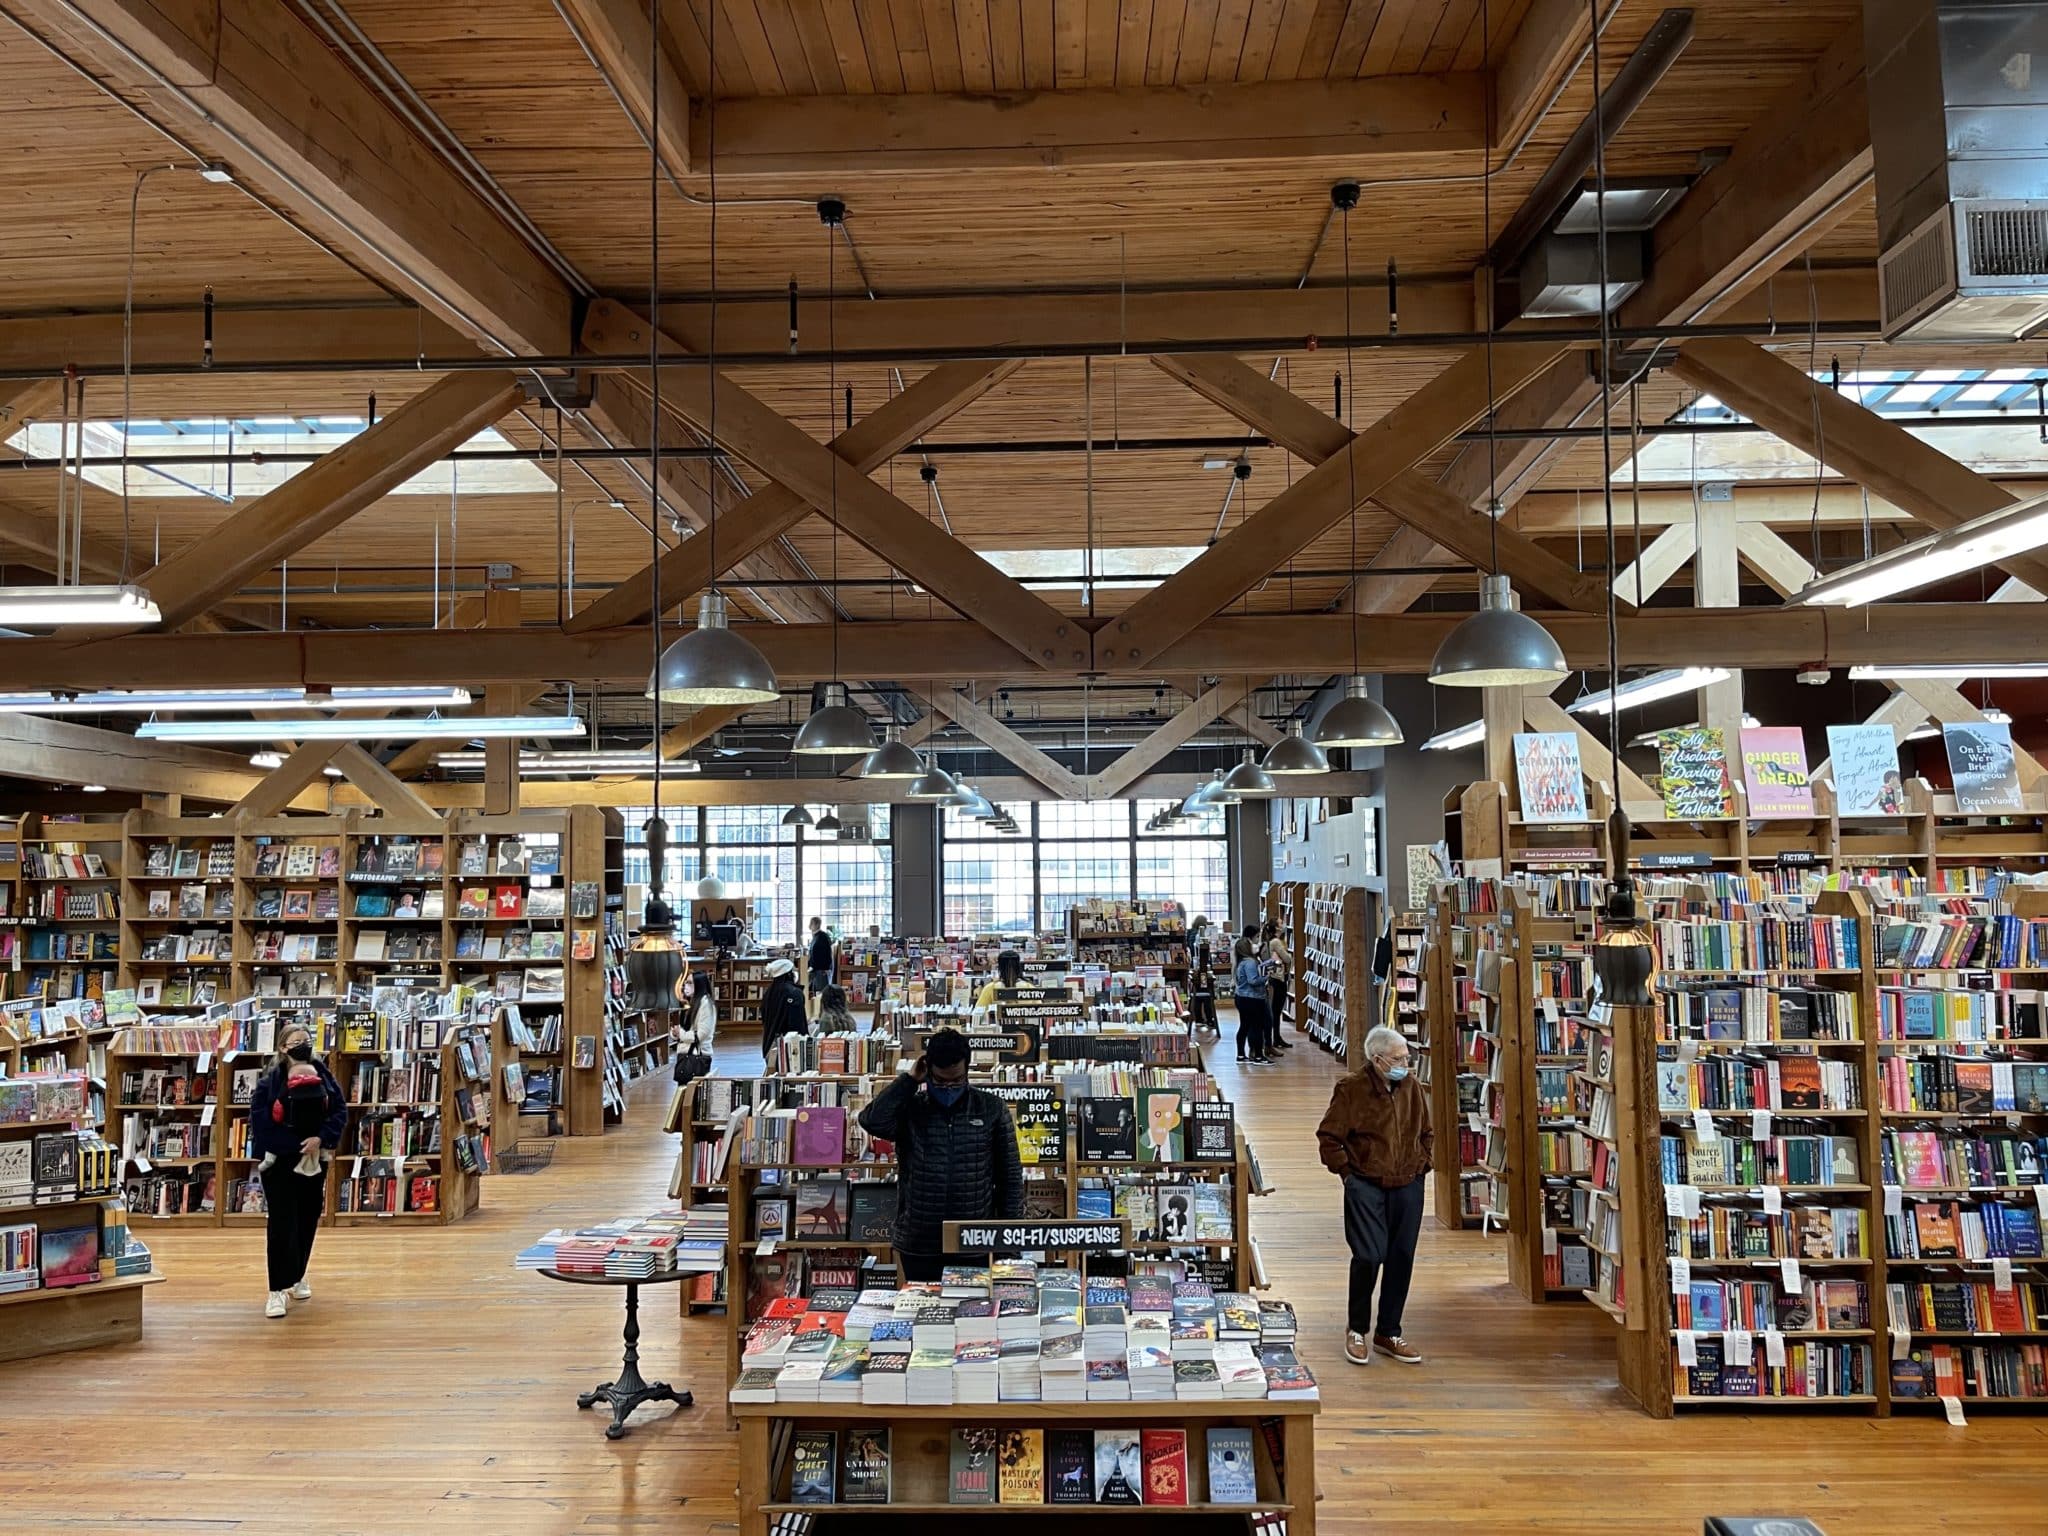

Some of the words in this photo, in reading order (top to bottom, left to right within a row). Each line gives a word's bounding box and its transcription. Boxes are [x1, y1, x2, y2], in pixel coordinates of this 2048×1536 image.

[1680, 733, 1705, 750] My
[1519, 756, 1578, 767] SEPARATION
[1664, 750, 1725, 763] Absolute
[1745, 751, 1800, 764] GINGER
[1968, 754, 1994, 762] We're
[1837, 766, 1865, 785] Forget
[1868, 758, 1896, 773] About
[1968, 762, 1999, 771] Briefly
[1667, 766, 1723, 782] Darling
[1758, 772, 1806, 785] BREAD
[1964, 771, 2006, 781] Gorgeous
[1671, 784, 1722, 802] Gabriel
[1845, 788, 1875, 809] You
[1962, 797, 1990, 805] Ocean
[1990, 797, 2019, 807] Vuong
[1529, 803, 1580, 813] KITAMURA
[1677, 800, 1725, 815] Tallent
[1658, 856, 1694, 864] ROMANCE
[1783, 853, 1810, 862] FICTION
[350, 873, 398, 881] PHOTOGRAPHY
[21, 917, 37, 925] ARTS
[1024, 963, 1047, 971] POETRY
[1017, 991, 1045, 999] POETRY
[281, 999, 311, 1008] MUSIC
[969, 1038, 1013, 1048] CRITICISM
[1782, 1065, 1818, 1073] GRISHAM
[979, 1087, 1050, 1100] TEWORTHY
[1029, 1103, 1050, 1112] BOB
[1212, 1112, 1231, 1120] GRAVE
[1020, 1136, 1037, 1144] ALL
[1040, 1136, 1060, 1144] THE
[1022, 1147, 1058, 1155] SONGS
[1691, 1146, 1720, 1156] lauren
[961, 1229, 997, 1246] NEW
[1003, 1227, 1121, 1246] SCI-FI/SUSPENSE
[1746, 1227, 1768, 1237] LAST
[1744, 1239, 1768, 1250] GIFT
[1205, 1263, 1230, 1271] Building
[811, 1270, 856, 1285] EBONY
[796, 1460, 828, 1472] GUEST
[804, 1471, 822, 1482] LIST
[1003, 1480, 1039, 1488] POISONS
